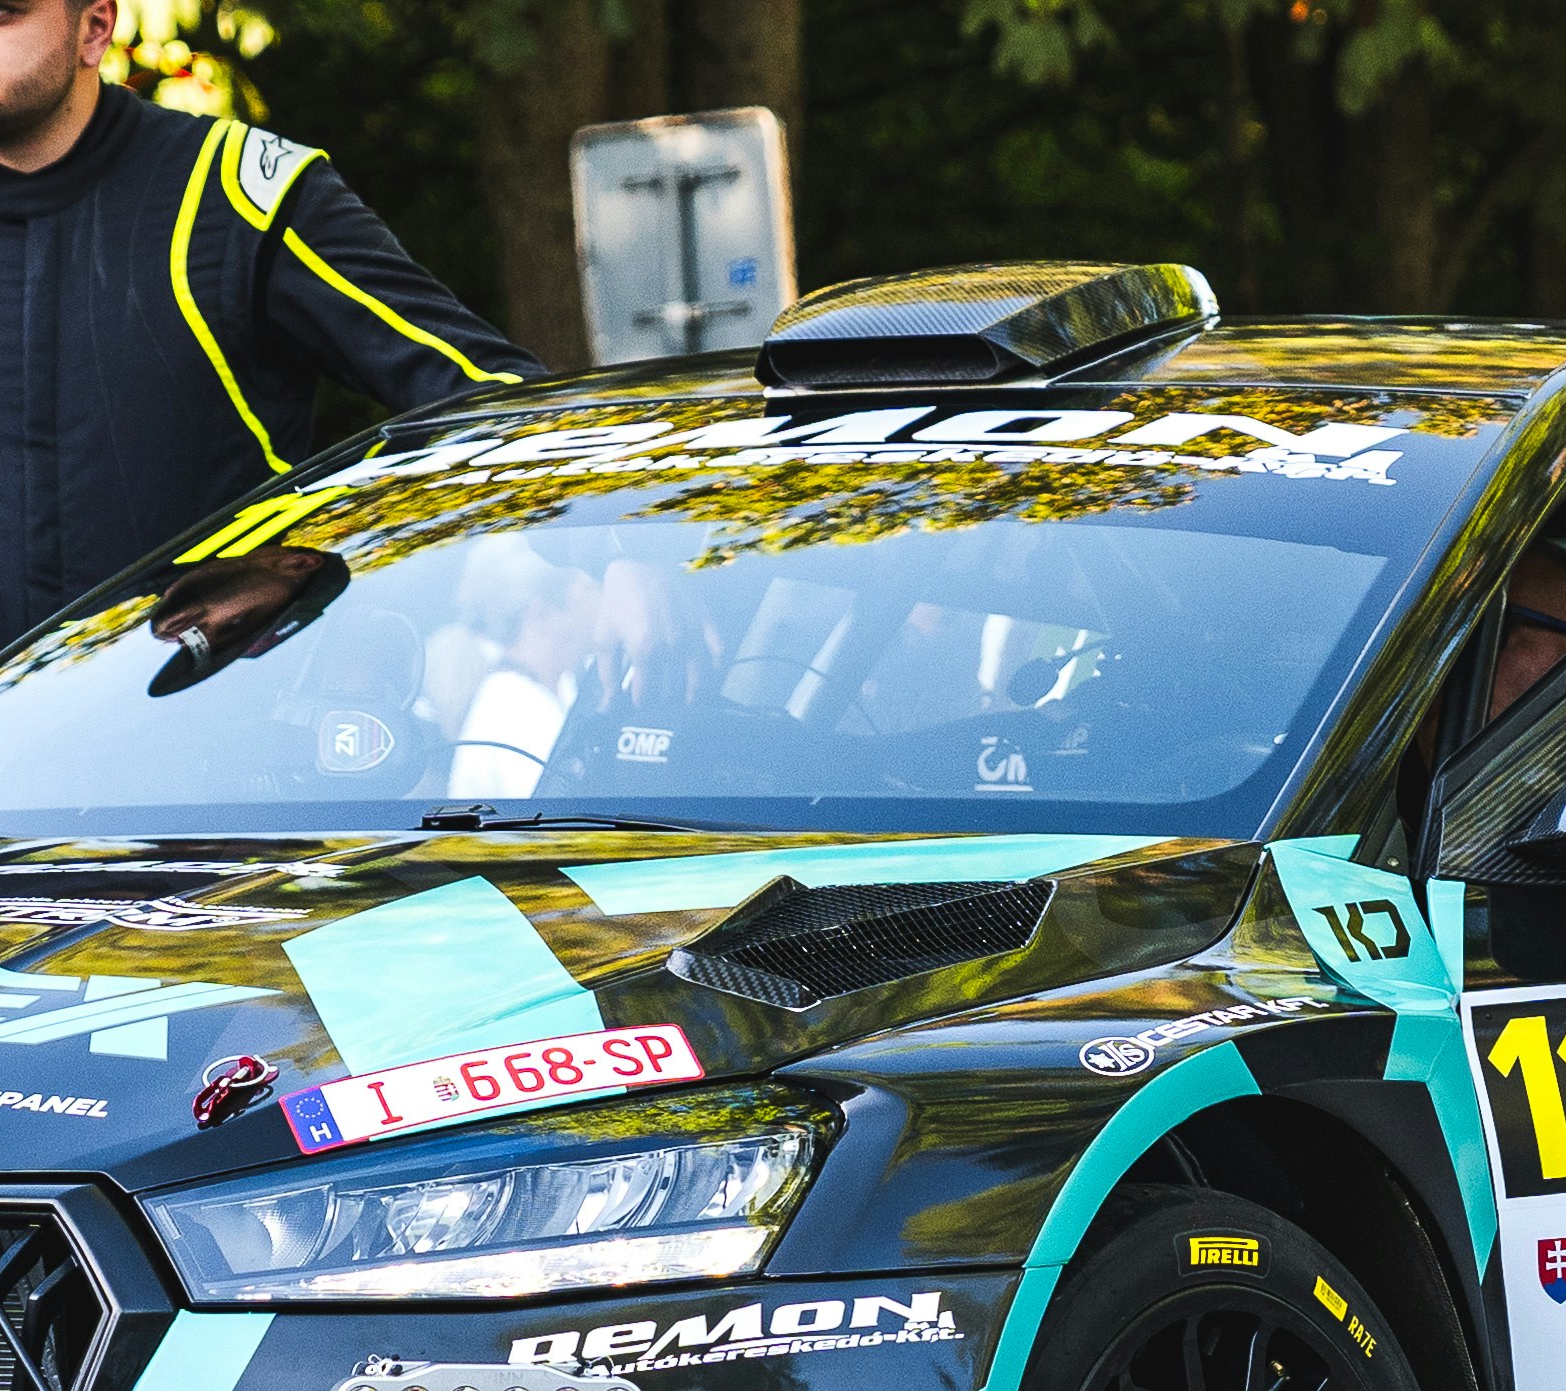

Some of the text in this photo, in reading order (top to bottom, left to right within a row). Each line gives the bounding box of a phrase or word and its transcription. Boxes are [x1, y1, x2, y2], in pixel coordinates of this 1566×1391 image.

[617, 731, 671, 756] OMP
[459, 1033, 674, 1103] 668-SP
[309, 1121, 334, 1144] H
[1189, 1236, 1259, 1267] PIRELLI
